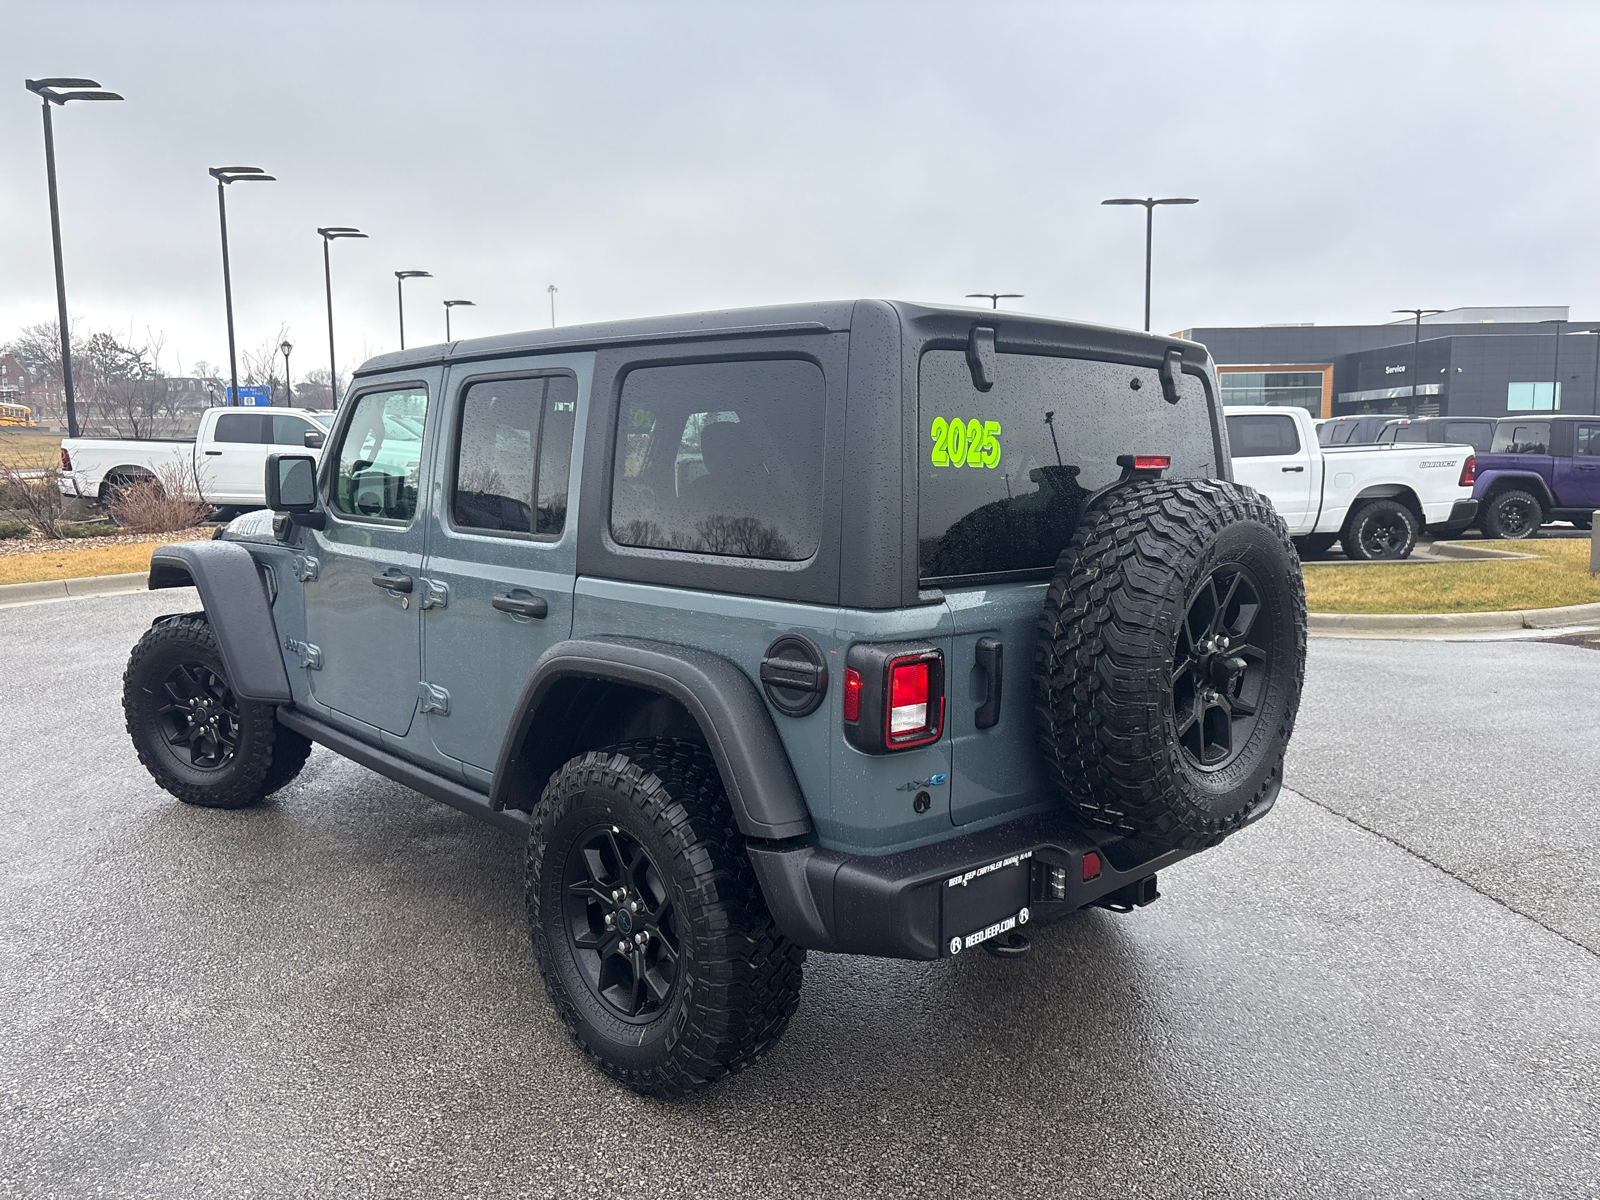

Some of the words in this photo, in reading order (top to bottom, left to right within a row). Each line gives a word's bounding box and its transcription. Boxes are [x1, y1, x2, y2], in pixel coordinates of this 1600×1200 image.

[1385, 364, 1406, 375] Service
[931, 416, 1001, 469] 2025
[965, 916, 1016, 949] REEDJEEP.COM
